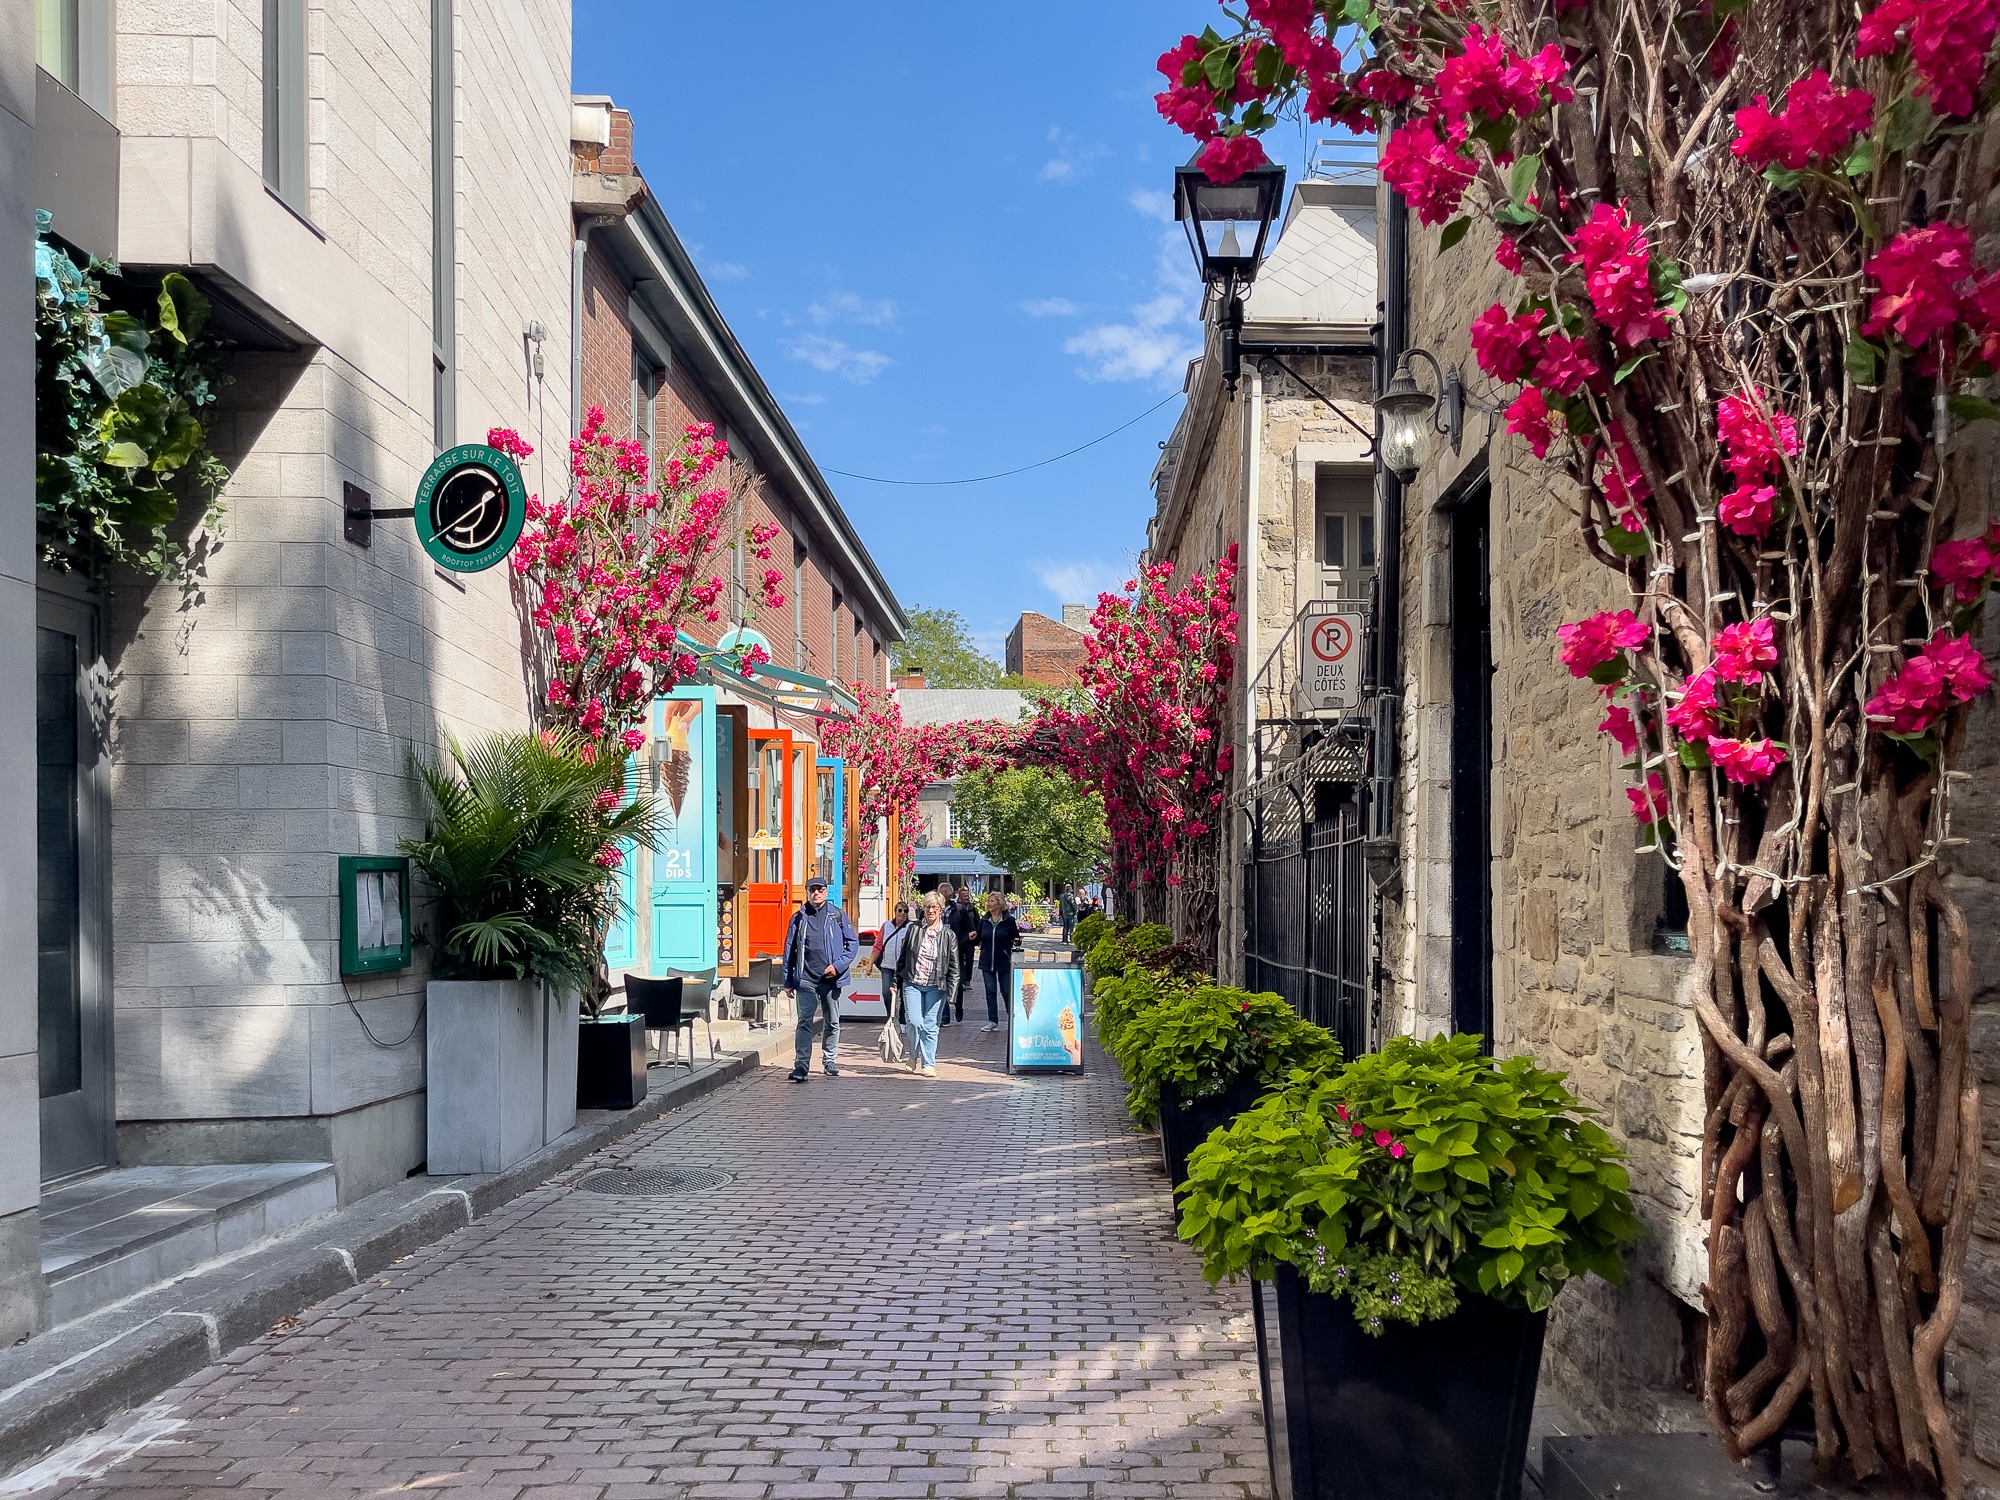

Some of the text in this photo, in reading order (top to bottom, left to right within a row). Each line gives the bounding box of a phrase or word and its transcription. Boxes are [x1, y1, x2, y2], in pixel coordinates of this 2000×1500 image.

[419, 449, 520, 505] TERRASSE SUR LE TOIT
[441, 544, 505, 567] ROOFTOP TERRACE
[1326, 628, 1341, 651] P
[1317, 664, 1344, 677] DEUX
[1314, 676, 1346, 692] CÔTÉS
[666, 849, 691, 868] 21
[665, 868, 692, 879] DIPS
